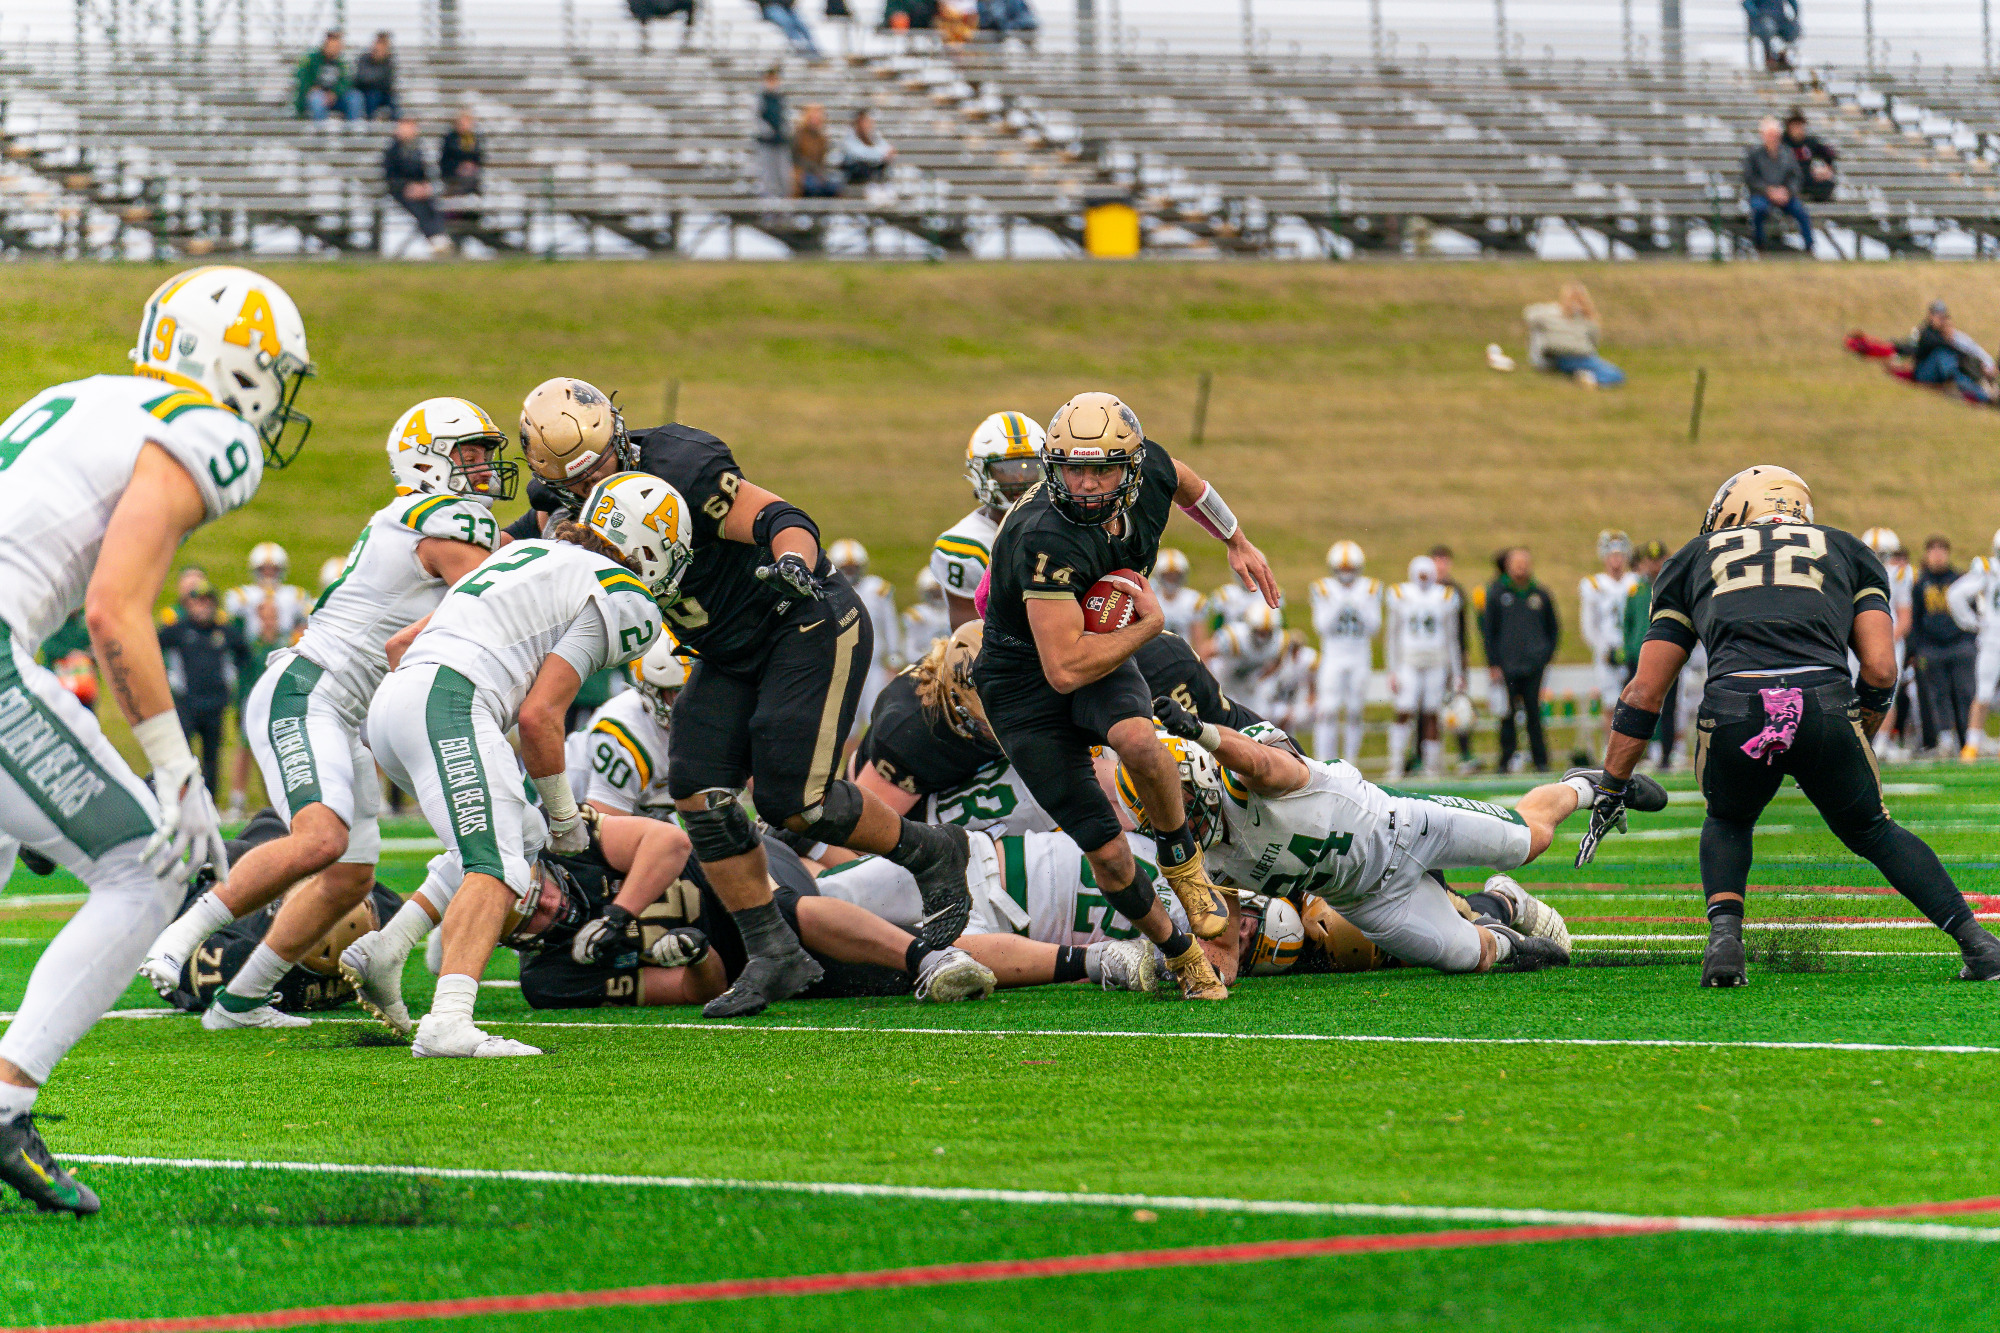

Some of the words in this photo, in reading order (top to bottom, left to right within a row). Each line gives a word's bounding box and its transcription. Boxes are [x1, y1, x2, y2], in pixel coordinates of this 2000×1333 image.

[152, 316, 177, 362] 9
[224, 289, 281, 357] A
[398, 408, 433, 452] A
[210, 438, 250, 488] 9
[592, 495, 616, 528] 2
[642, 493, 680, 544] A
[703, 472, 740, 519] 68
[451, 513, 497, 552] 33
[453, 546, 551, 598] 2
[947, 562, 965, 588] 8
[1032, 553, 1075, 586] 14
[1708, 526, 1828, 598] 22
[1100, 590, 1122, 624] Wilson
[620, 619, 654, 653] 2
[27, 742, 106, 817] BEARS
[282, 751, 314, 793] BEARS
[437, 736, 480, 789] GOLDEN
[594, 742, 631, 789] 90
[452, 787, 488, 837] BEARS
[1250, 842, 1283, 882] ALBERTA
[198, 948, 223, 985] 71
